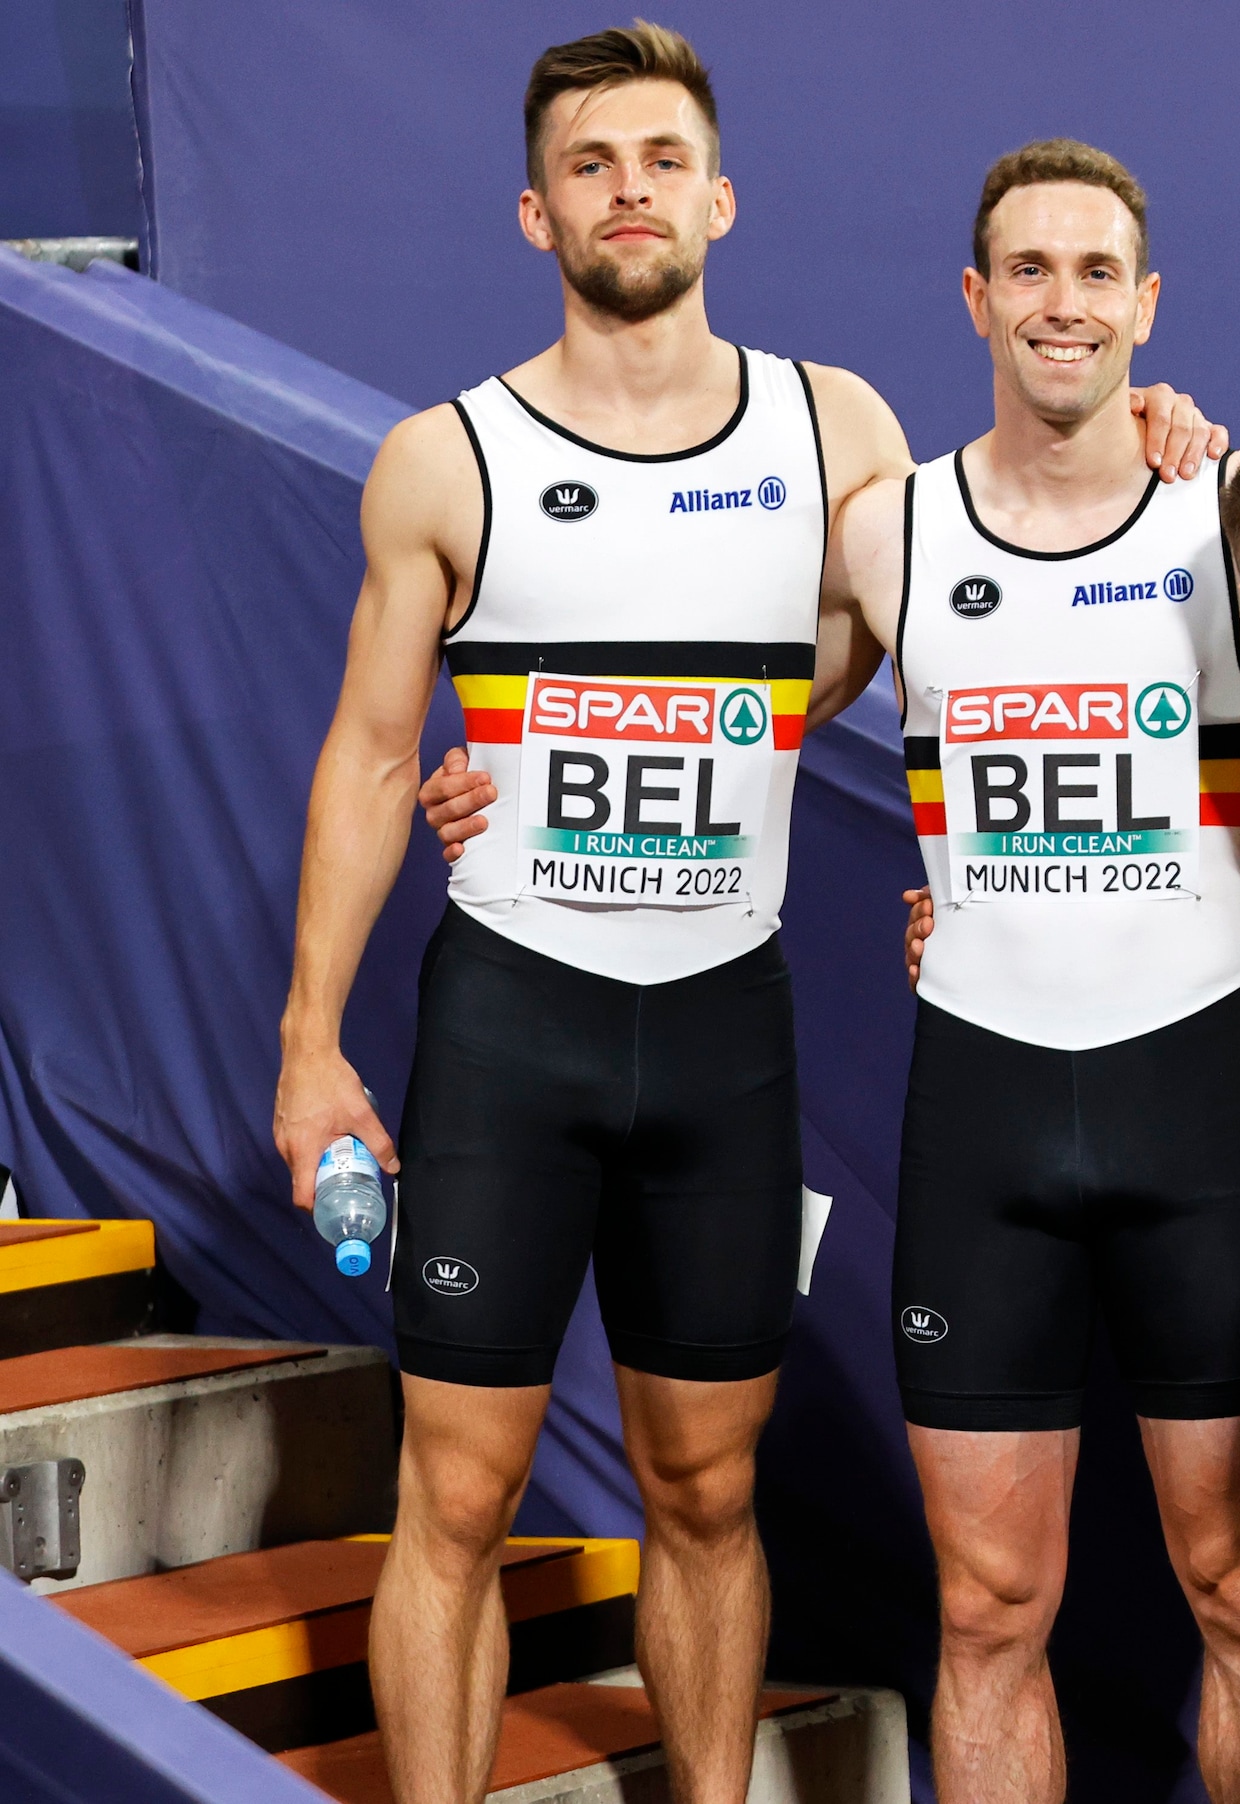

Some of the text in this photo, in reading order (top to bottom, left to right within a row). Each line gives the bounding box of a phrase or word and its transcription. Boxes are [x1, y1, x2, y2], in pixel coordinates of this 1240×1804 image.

[548, 503, 590, 514] vermarc
[669, 489, 753, 513] Allianz
[956, 600, 994, 610] vermarc
[1071, 581, 1158, 607] Allianz
[534, 687, 711, 735] SPAR
[950, 690, 1124, 735] SPAR
[547, 749, 741, 836] BEL
[970, 753, 1171, 833] BEL
[573, 834, 579, 852] I
[586, 835, 635, 855] RUN
[1002, 835, 1007, 853] I
[1011, 835, 1056, 853] RUN
[533, 858, 742, 896] MUNICH 2022
[966, 861, 1182, 893] MUNICH 2022
[428, 1278, 469, 1289] vermarc
[905, 1326, 939, 1337] vermarc
